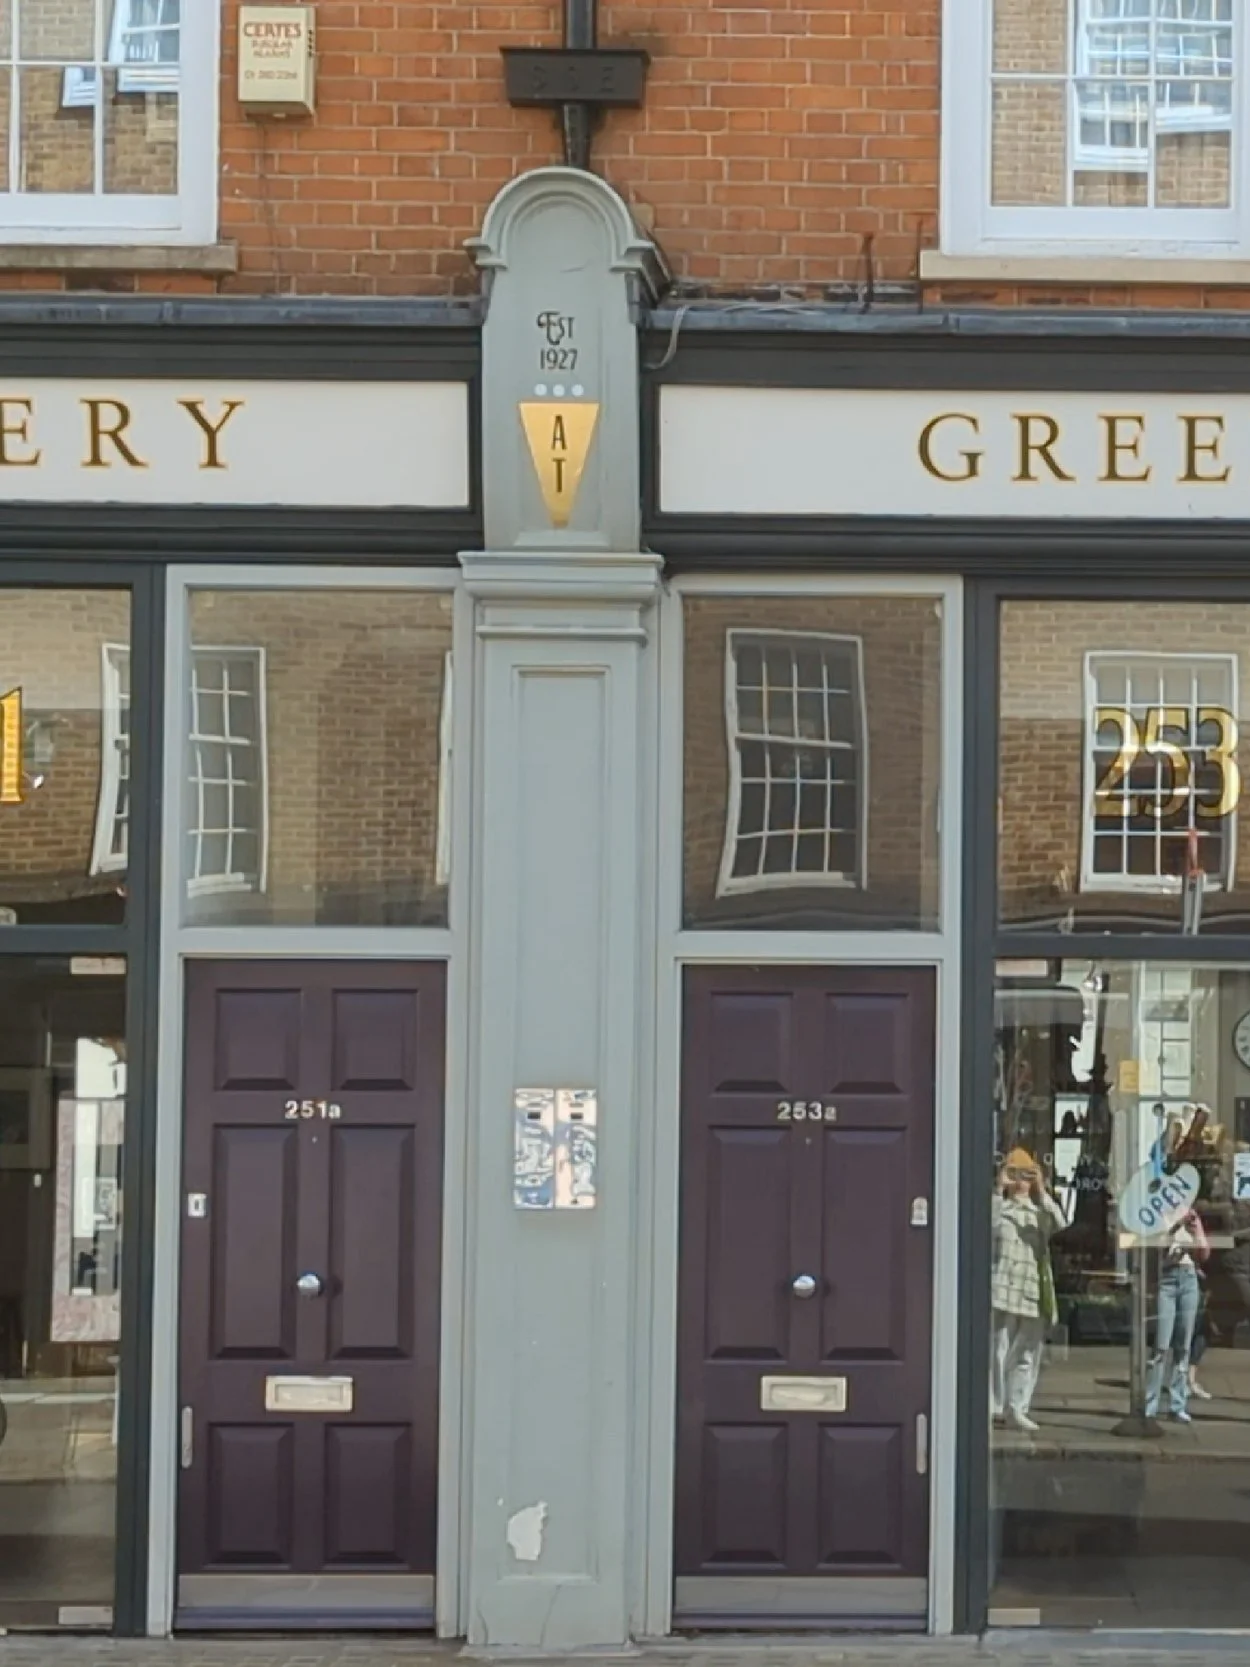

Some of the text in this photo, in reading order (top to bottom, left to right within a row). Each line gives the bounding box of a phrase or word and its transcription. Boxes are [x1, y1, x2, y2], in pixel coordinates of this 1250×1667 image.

[540, 347, 579, 371] 1927
[1092, 705, 1242, 819] 253
[284, 1099, 341, 1120] 251a
[777, 1101, 838, 1121] 253a
[1138, 1174, 1192, 1227] OPEN
